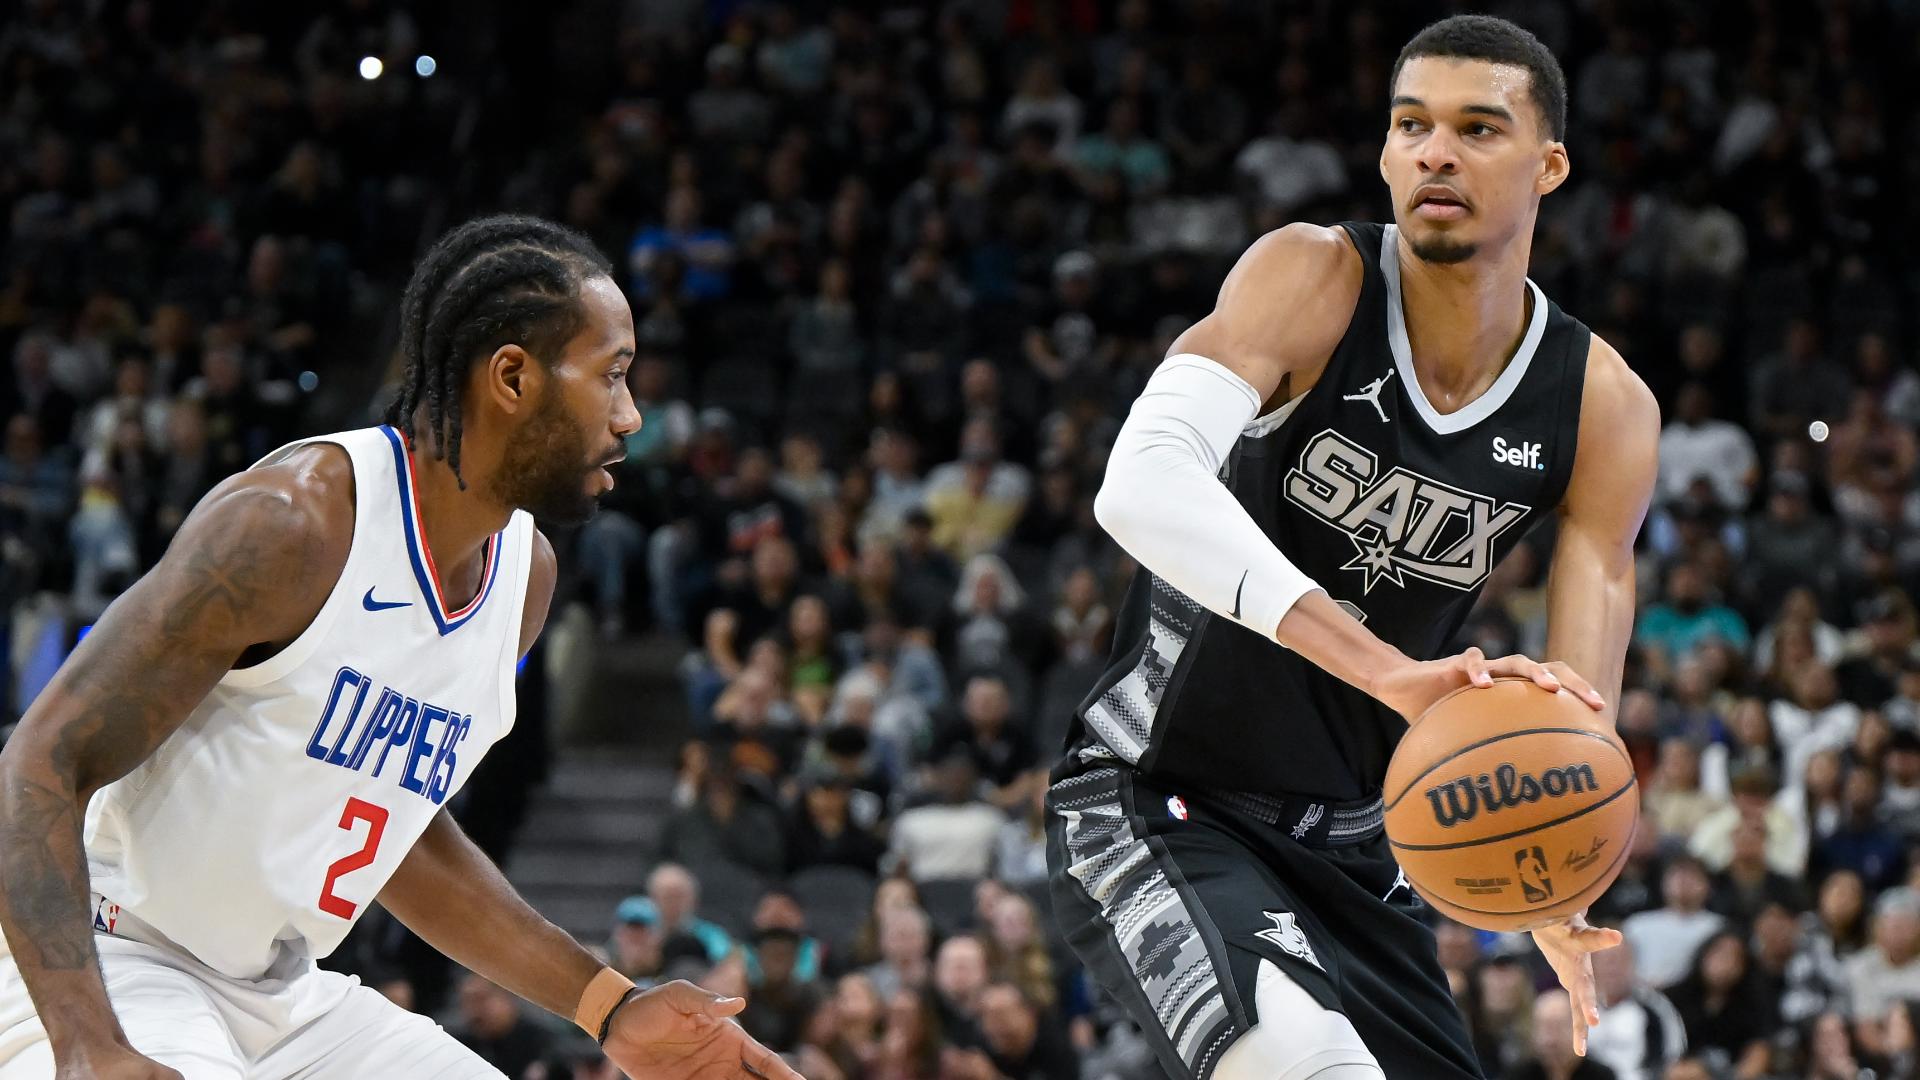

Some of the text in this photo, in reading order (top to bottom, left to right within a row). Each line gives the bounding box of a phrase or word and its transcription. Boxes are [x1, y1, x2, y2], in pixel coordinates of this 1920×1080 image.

[1284, 428, 1532, 592] SATX
[306, 666, 472, 805] CLIPPERS
[1425, 761, 1599, 828] Wilson
[318, 796, 389, 920] 2
